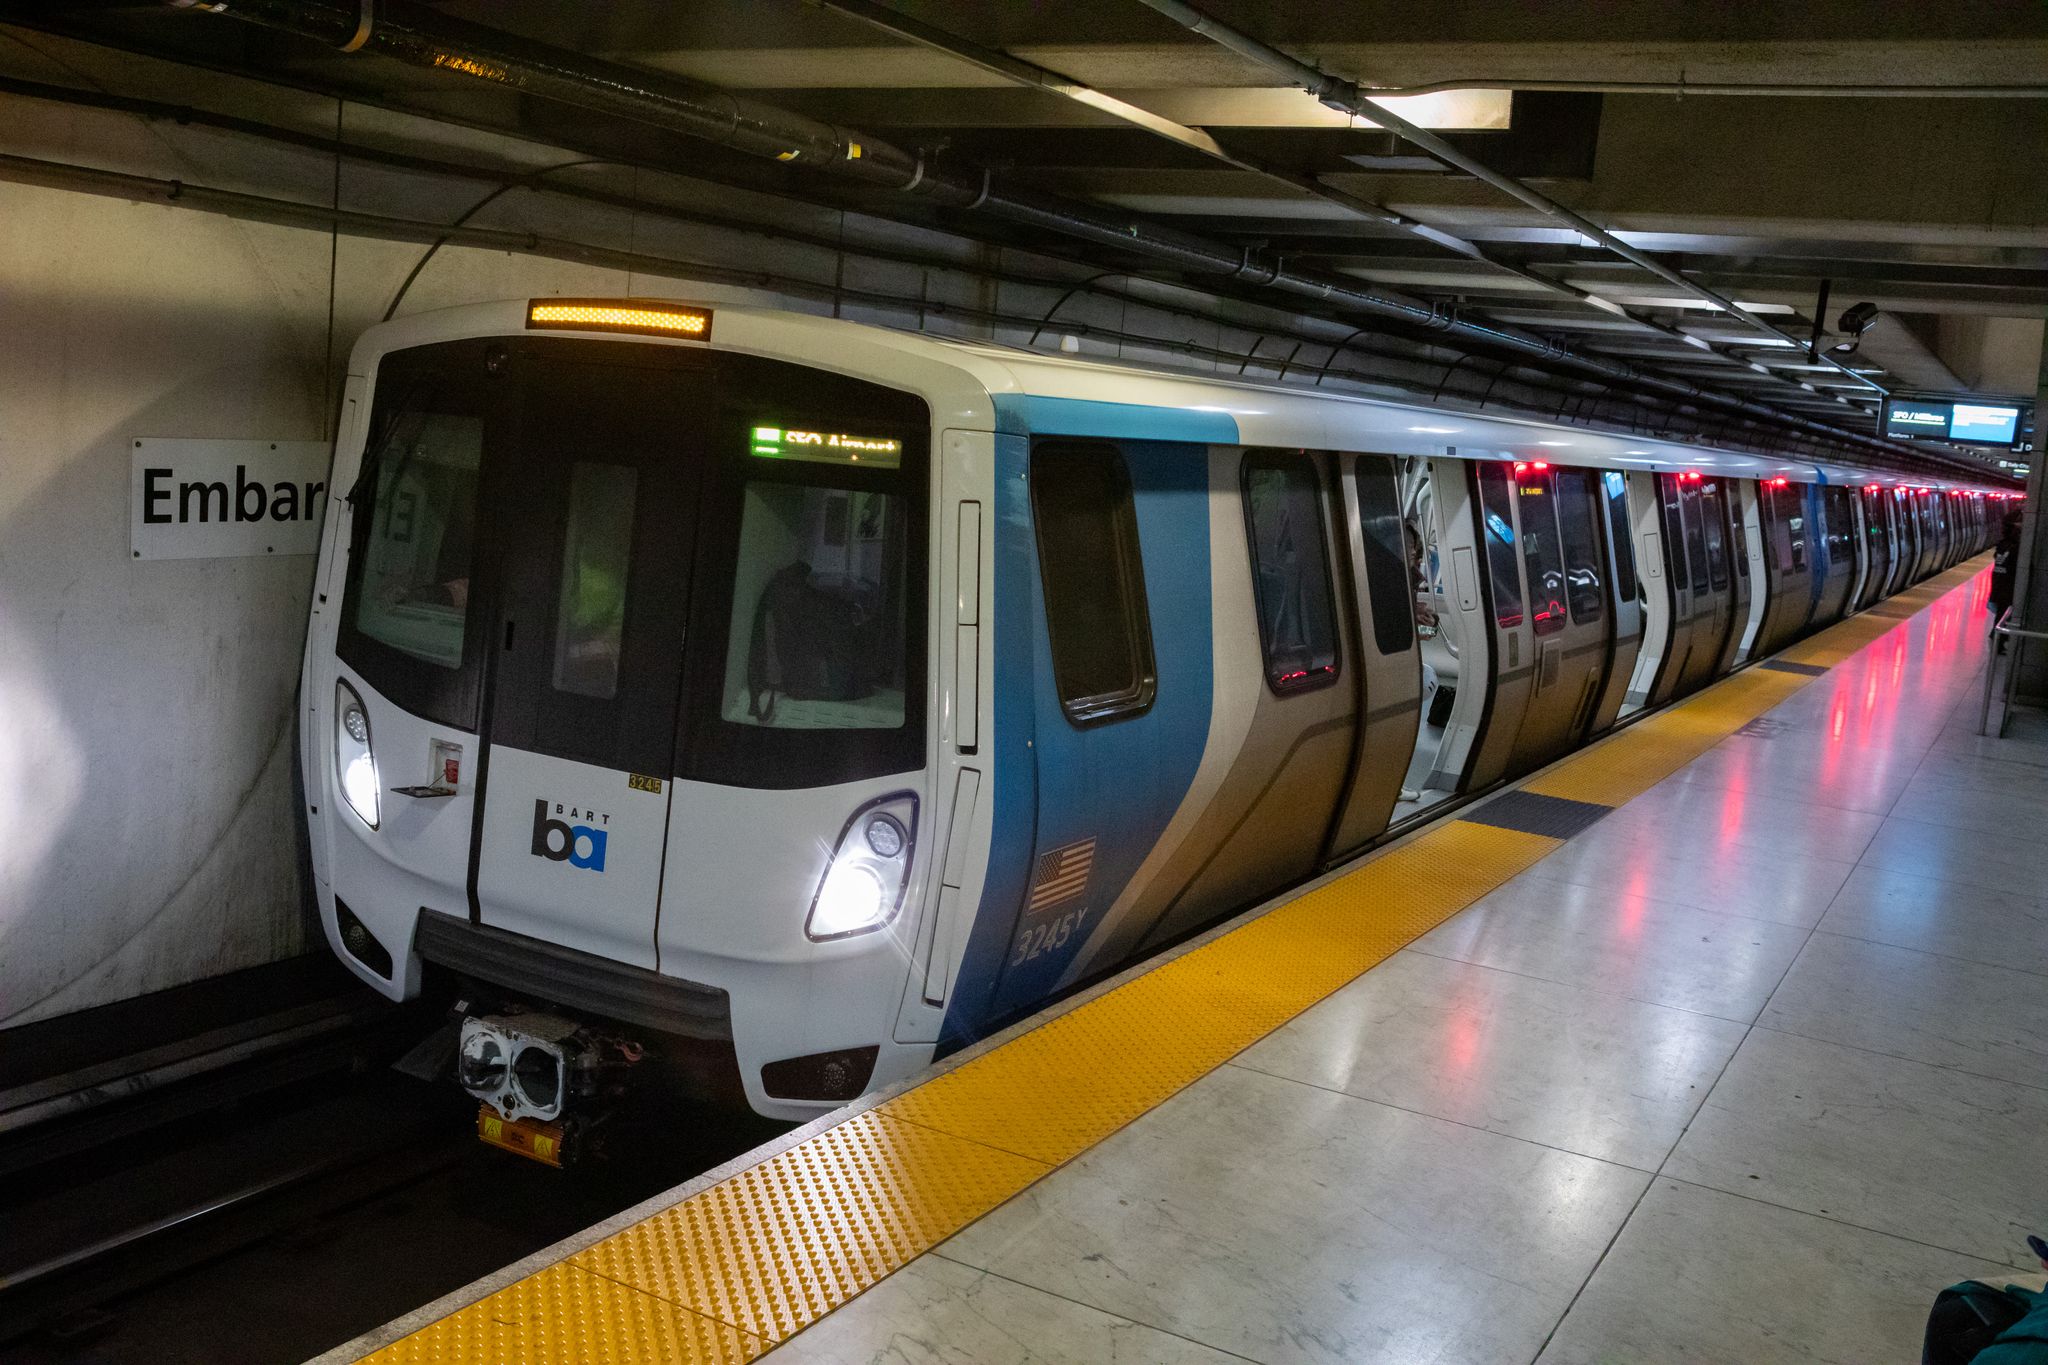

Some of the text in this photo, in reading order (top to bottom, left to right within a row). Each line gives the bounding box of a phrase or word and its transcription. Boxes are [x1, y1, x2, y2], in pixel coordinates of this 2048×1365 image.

[143, 465, 324, 523] Embar
[629, 774, 662, 793] 3245
[556, 804, 610, 825] BART
